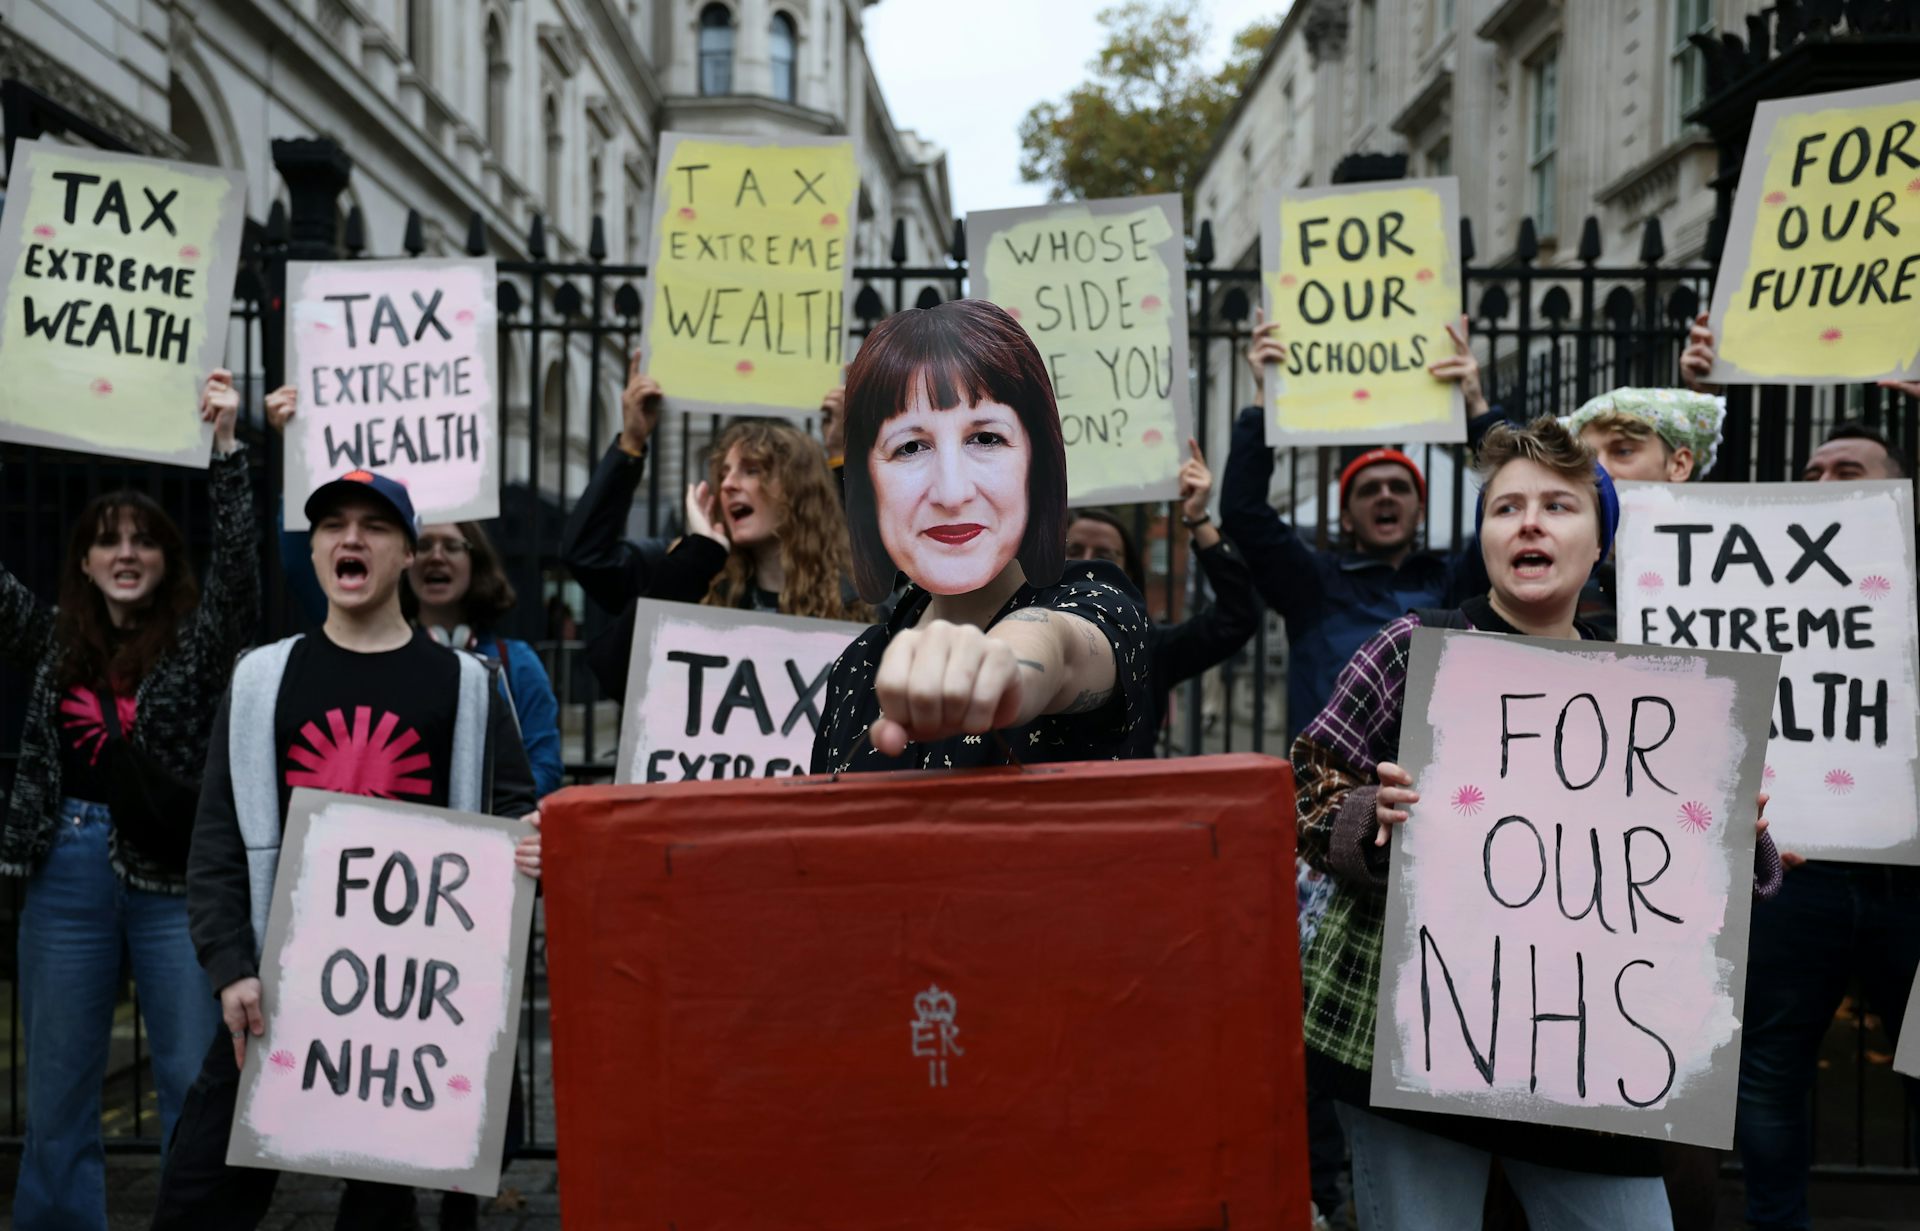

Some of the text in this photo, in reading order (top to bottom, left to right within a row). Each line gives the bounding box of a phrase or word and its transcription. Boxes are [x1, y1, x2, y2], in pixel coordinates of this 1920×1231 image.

[1791, 119, 1920, 188] FOR
[52, 171, 178, 236] TAX
[1777, 191, 1900, 250] OUR
[670, 231, 843, 272] EXTREME
[1004, 218, 1149, 265] WHOSE
[1299, 211, 1415, 266] FOR
[24, 244, 195, 298] EXTREME
[1298, 276, 1416, 325] OUR
[1748, 253, 1920, 312] FUTURE
[23, 296, 192, 364] WEALTH
[323, 289, 452, 349] TAX
[663, 285, 845, 365] WEALTH
[1036, 276, 1136, 332] SIDE
[311, 356, 471, 406] EXTREME
[1095, 344, 1174, 400] YOU
[1287, 334, 1428, 376] SCHOOLS
[324, 412, 479, 468] WEALTH
[1061, 408, 1128, 447] ON?
[1654, 522, 1853, 587] TAX
[1641, 604, 1876, 652] EXTREME
[667, 650, 833, 737] TAX
[1769, 671, 1888, 748] LTH
[1500, 692, 1678, 798] FOR
[335, 847, 475, 931] FOR
[1482, 814, 1685, 934] OUR
[321, 948, 464, 1026] OUR
[1419, 924, 1676, 1109] NHS
[910, 1020, 964, 1056] ER
[301, 1039, 447, 1111] NHS
